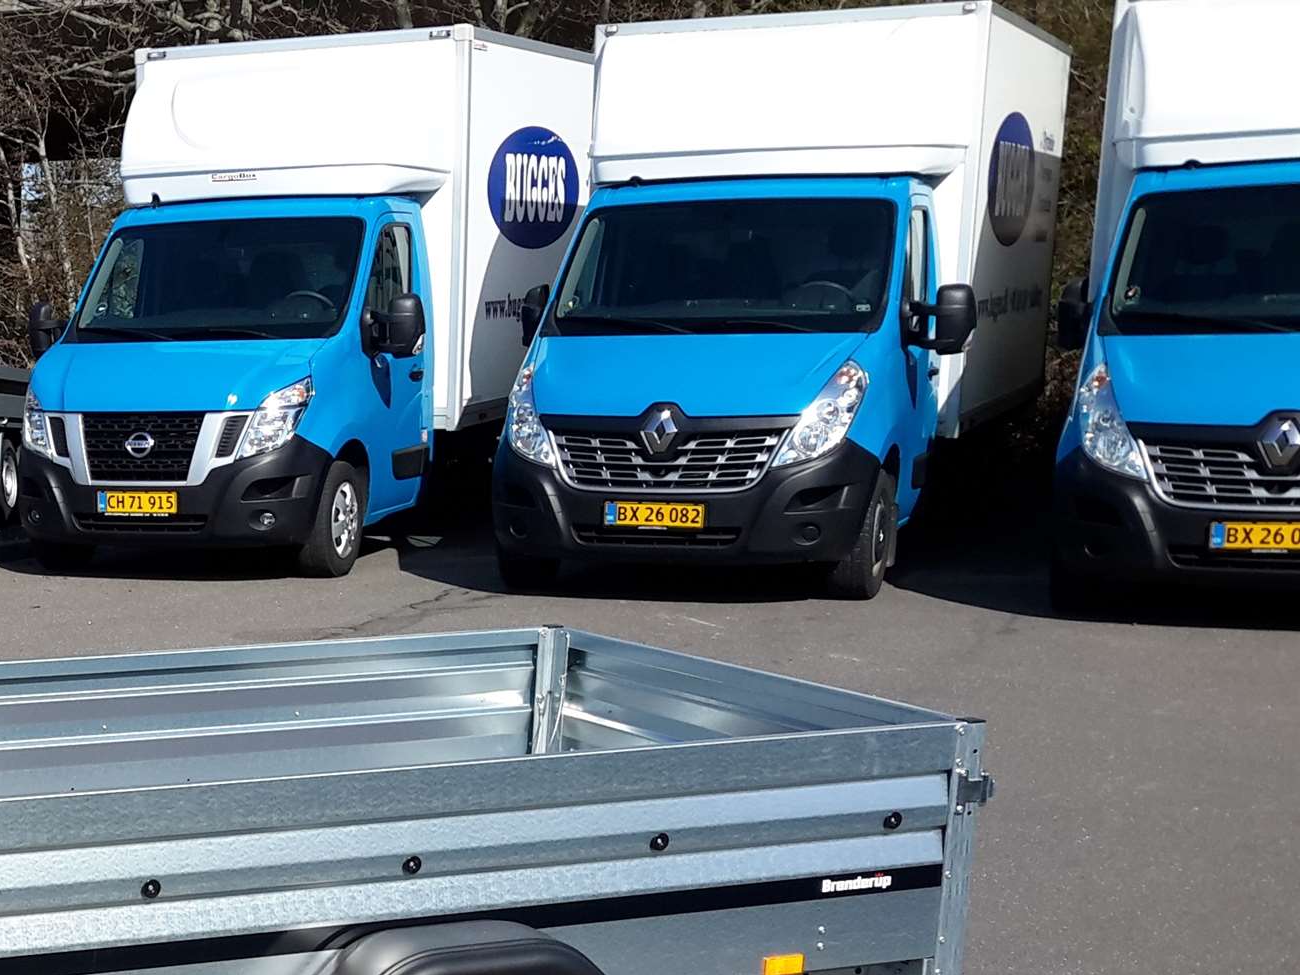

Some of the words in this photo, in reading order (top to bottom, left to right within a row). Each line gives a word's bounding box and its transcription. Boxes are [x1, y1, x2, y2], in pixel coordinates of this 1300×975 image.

[504, 153, 566, 222] BUGGES
[107, 495, 125, 509] CH
[129, 495, 143, 510] 71
[148, 495, 174, 510] 915
[618, 506, 640, 521] BX
[644, 507, 664, 522] 26
[669, 507, 701, 524] 082
[1227, 527, 1254, 544] BX
[1260, 527, 1285, 545] 26
[821, 875, 892, 893] Brenderup
